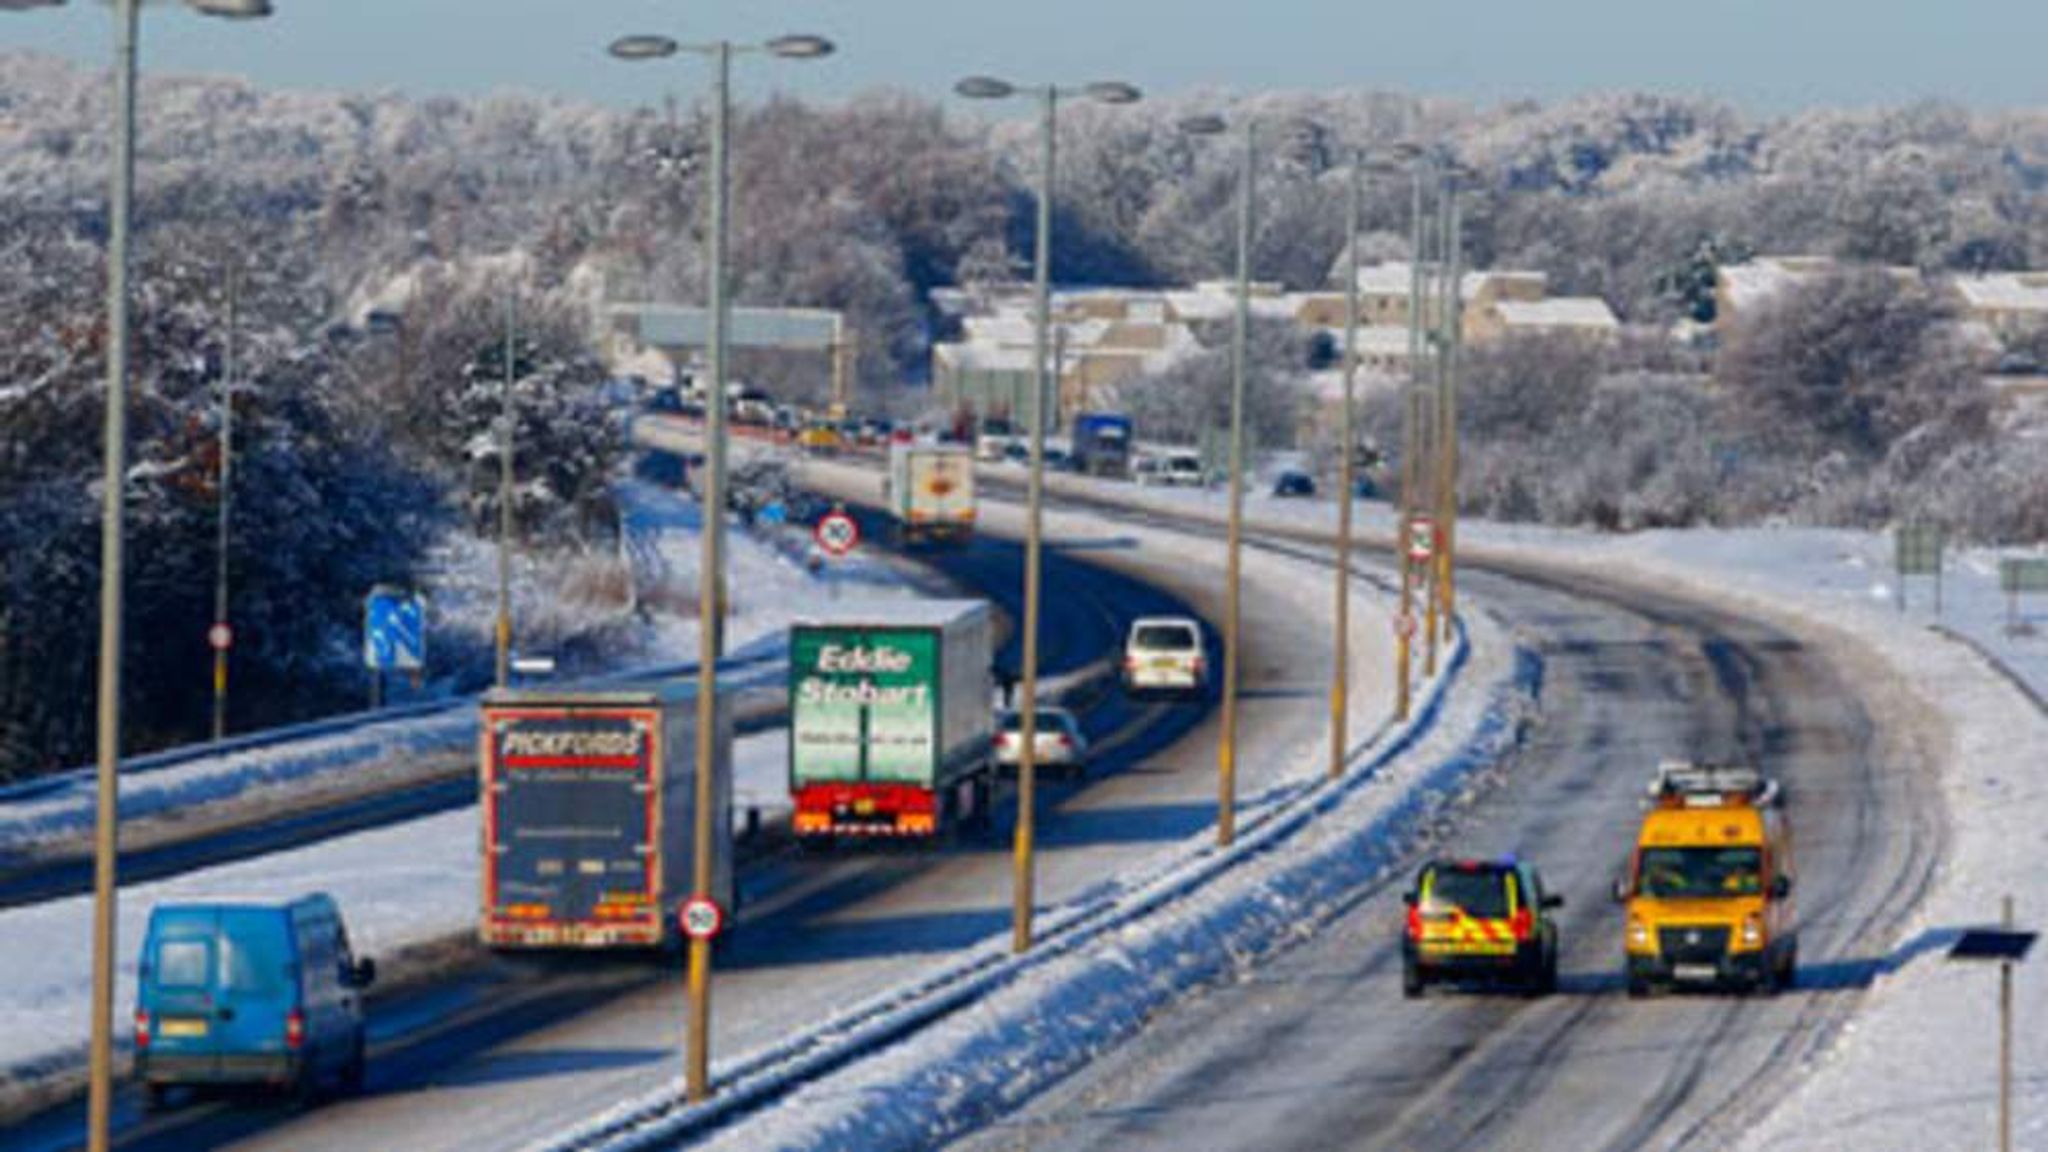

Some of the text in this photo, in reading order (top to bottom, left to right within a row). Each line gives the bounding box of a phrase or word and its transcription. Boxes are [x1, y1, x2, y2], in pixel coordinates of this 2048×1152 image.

[819, 645, 912, 672] Eddie
[801, 677, 927, 705] Stobart
[503, 732, 641, 755] PICKFORDS
